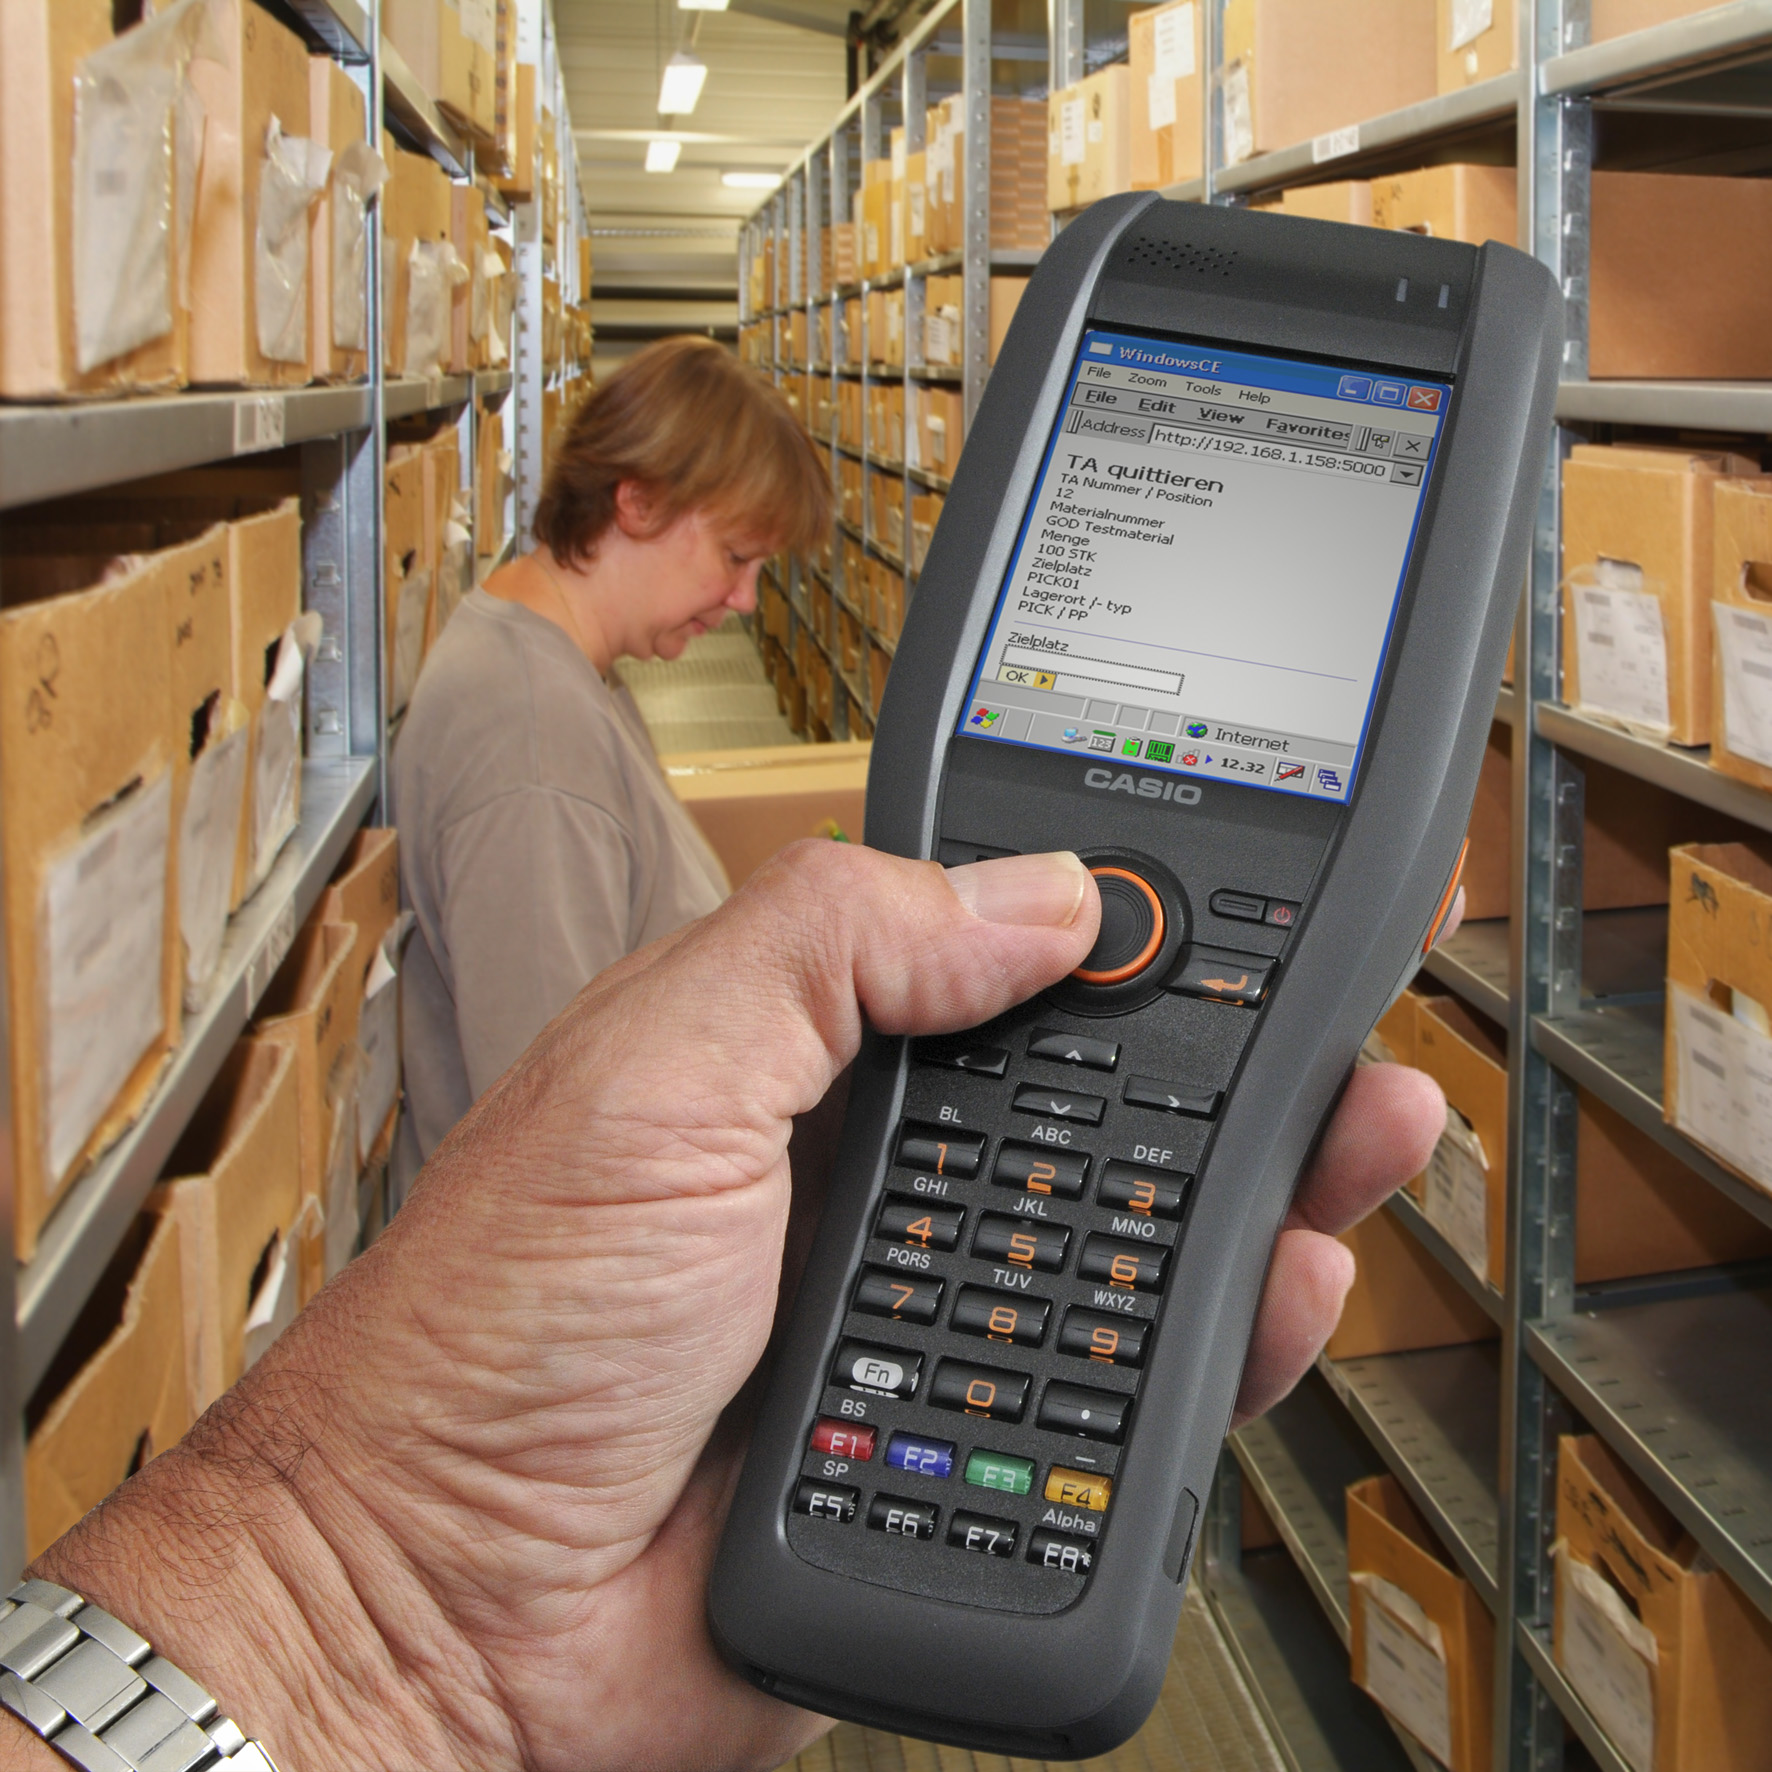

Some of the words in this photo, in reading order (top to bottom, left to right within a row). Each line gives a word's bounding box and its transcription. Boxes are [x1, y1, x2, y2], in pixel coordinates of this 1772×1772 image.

[1120, 345, 1222, 374] WindowsCE
[1088, 366, 1111, 380] File
[1129, 372, 1167, 388] Zoom
[1185, 381, 1221, 397] Tools
[1239, 389, 1271, 405] Help
[1085, 389, 1117, 405] File
[1138, 398, 1176, 415] Edit
[1197, 406, 1245, 425] View
[1082, 418, 1146, 439] Address
[1155, 428, 1385, 478] http://192.168.1.158:5000
[1066, 454, 1098, 473] TA
[1107, 461, 1224, 494] quittieren
[1056, 487, 1073, 499] 12
[1060, 473, 1079, 486] TA
[1083, 477, 1142, 497] Nummer
[1157, 489, 1213, 508] Position
[1050, 501, 1165, 529] Materialnummer
[1041, 529, 1090, 547] Menge
[1046, 515, 1079, 530] GOD
[1084, 521, 1175, 546] Testmaterial
[1037, 543, 1066, 558] 100
[1068, 548, 1097, 562] STK
[1032, 557, 1092, 577] Zielplatz
[1027, 572, 1080, 590] PICK01
[1018, 600, 1054, 616] PICK
[1068, 609, 1088, 621] PP
[1022, 586, 1086, 607] Lagerort
[1106, 600, 1132, 615] typ
[1008, 631, 1069, 653] Zielplatz
[1006, 670, 1029, 684] OK
[1215, 727, 1290, 752] Internet
[1221, 758, 1265, 774] 12.32
[1084, 767, 1202, 805] CASIO
[940, 1106, 962, 1123] BL
[1031, 1126, 1072, 1145] ABC
[937, 1143, 947, 1170] 1
[1133, 1145, 1172, 1164] DEF
[914, 1177, 948, 1196] GHI
[1027, 1162, 1056, 1191] 2
[1128, 1180, 1156, 1209] 3
[1013, 1198, 1048, 1216] JKL
[907, 1216, 932, 1240] 4
[1112, 1217, 1155, 1238] MNO
[887, 1248, 931, 1269] PQRS
[1008, 1233, 1037, 1262] 5
[993, 1269, 1032, 1289] TUV
[1111, 1255, 1139, 1282] 6
[890, 1284, 914, 1310] 7
[1093, 1290, 1136, 1311] WXYZ
[988, 1307, 1018, 1333] 8
[1090, 1328, 1118, 1354] 9
[864, 1363, 890, 1383] Fn
[840, 1399, 867, 1417] BS
[830, 1432, 856, 1455] F1
[823, 1460, 848, 1477] SP
[903, 1447, 938, 1472] F2
[983, 1466, 1015, 1489] F3
[809, 1492, 844, 1518] F5
[1060, 1483, 1091, 1505] F4
[886, 1510, 918, 1535] F6
[1042, 1508, 1096, 1532] Alpha
[966, 1526, 1000, 1551] F7
